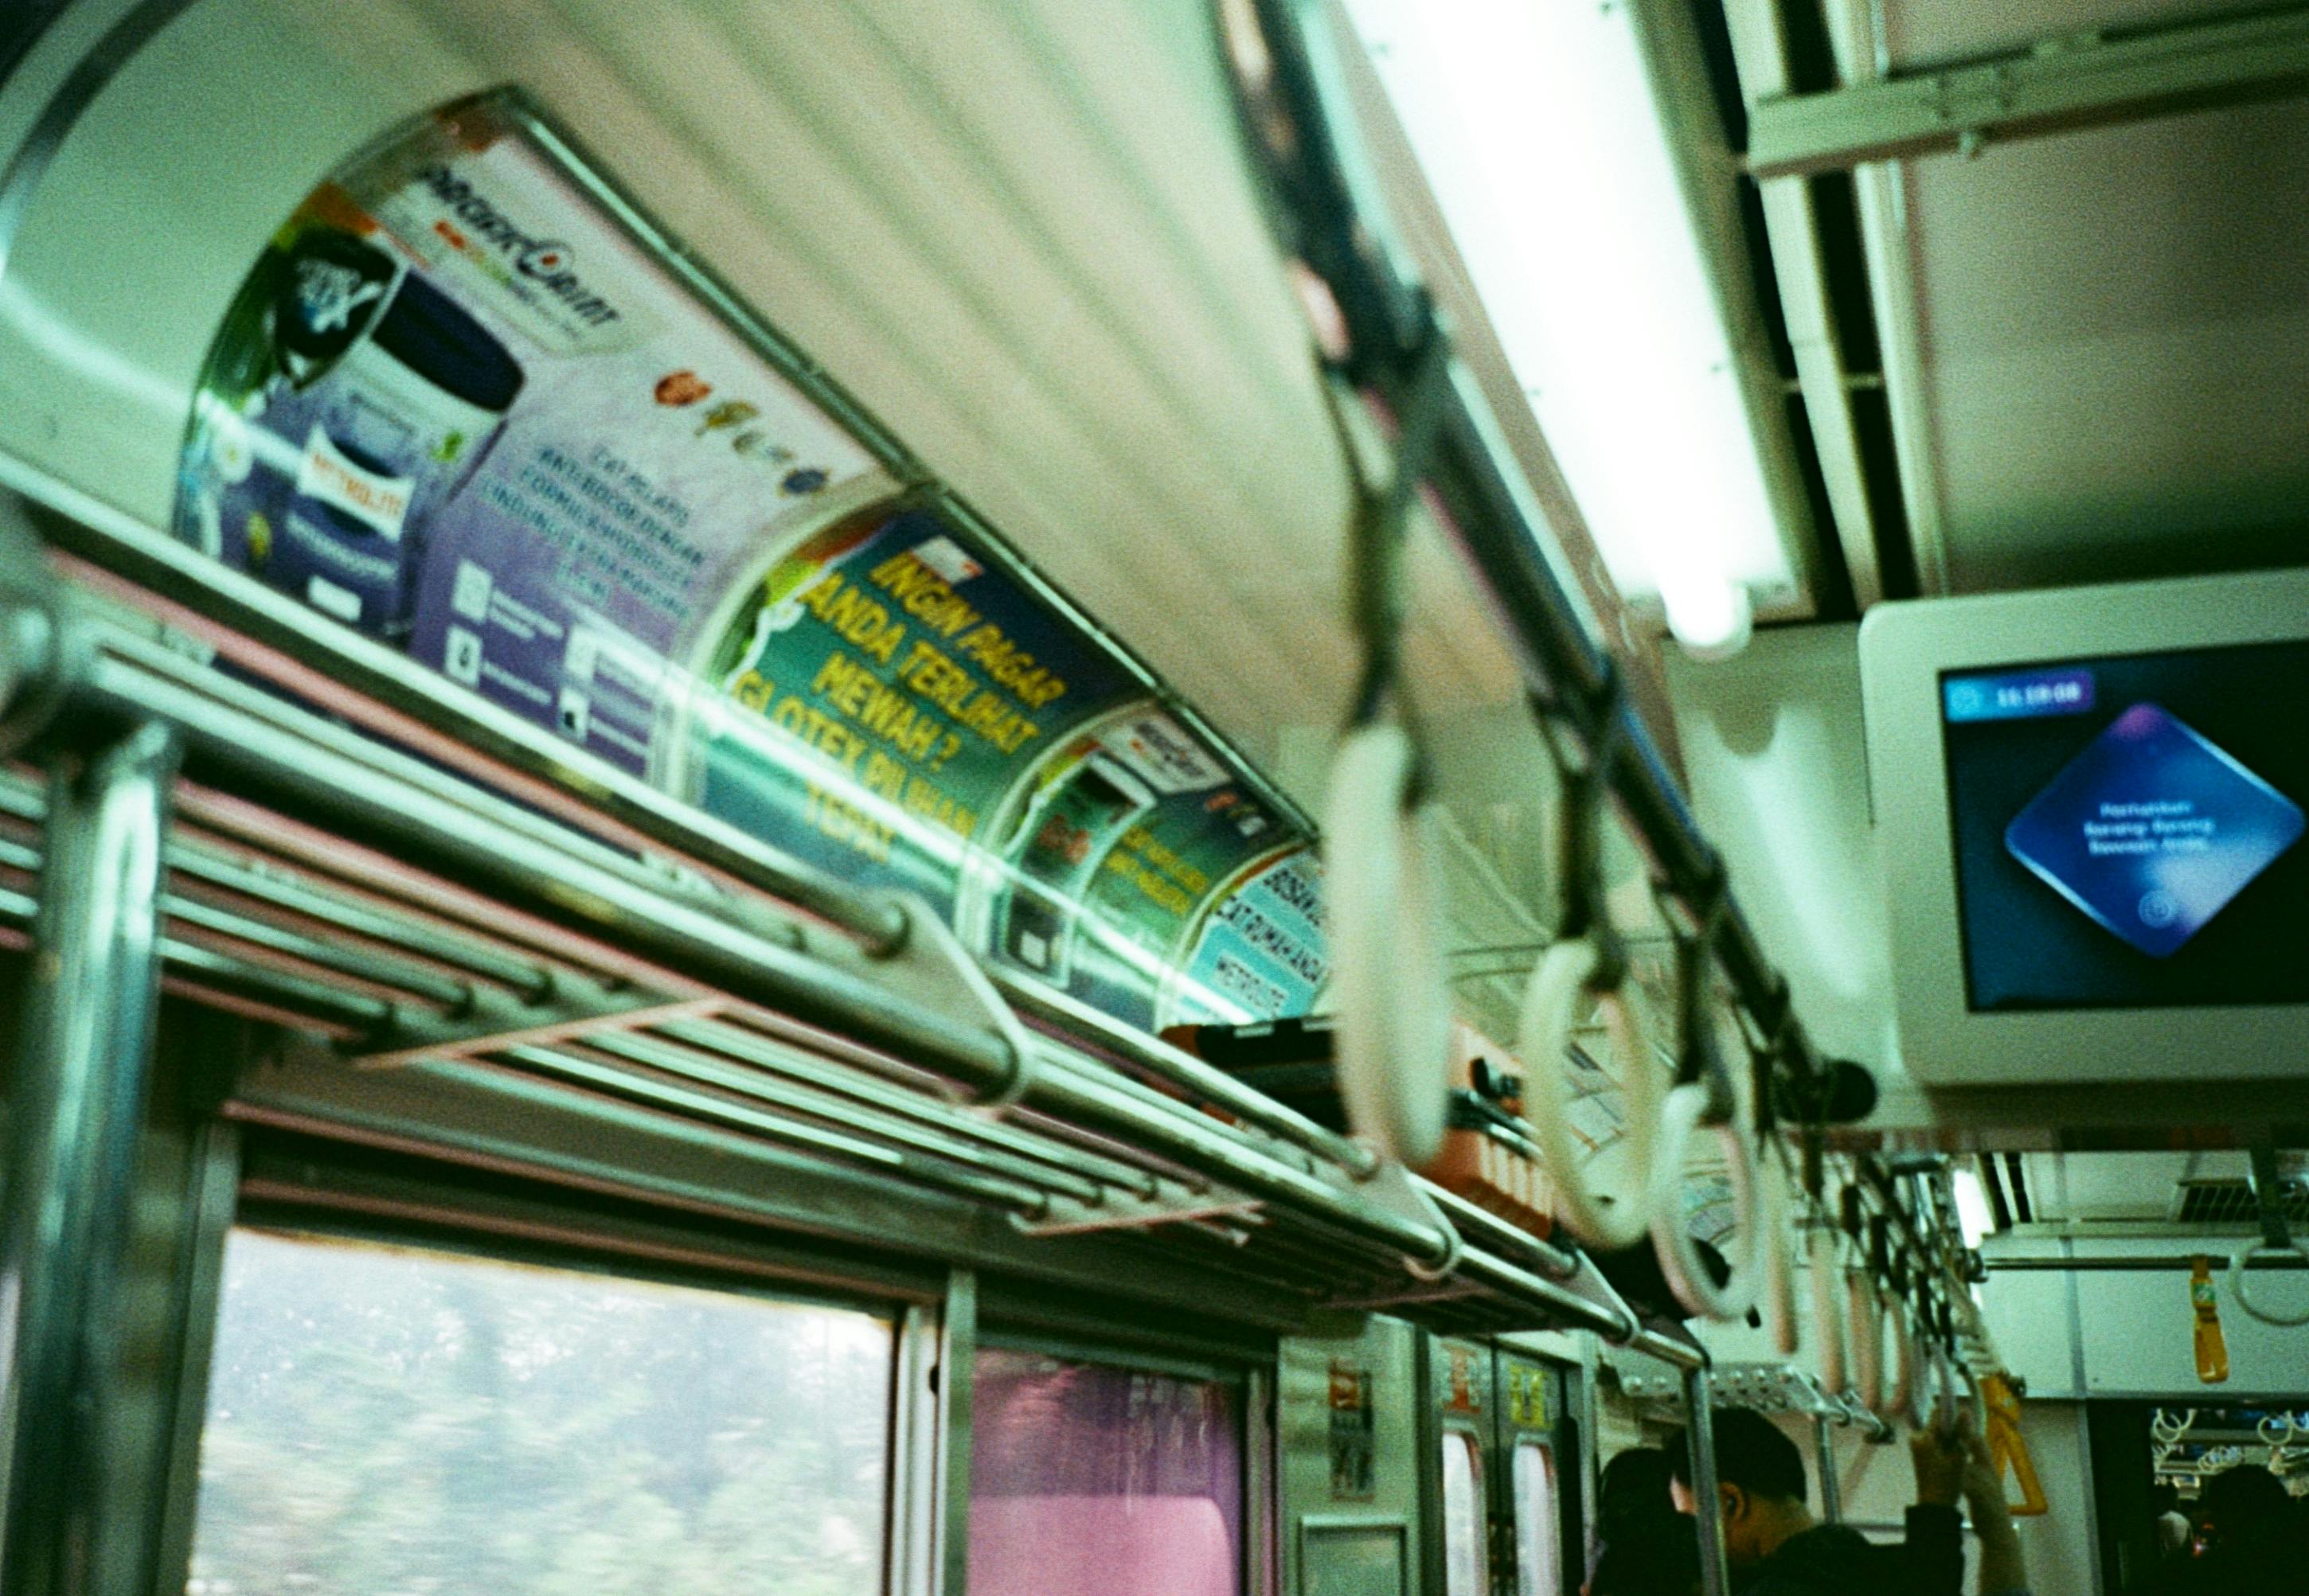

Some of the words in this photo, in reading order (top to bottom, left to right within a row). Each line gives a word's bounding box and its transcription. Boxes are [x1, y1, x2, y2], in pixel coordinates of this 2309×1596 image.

[795, 572, 908, 664] ANDA
[898, 639, 1041, 755] TERLIHAT
[869, 552, 982, 637] INGIN
[955, 624, 1068, 709] PAGAR
